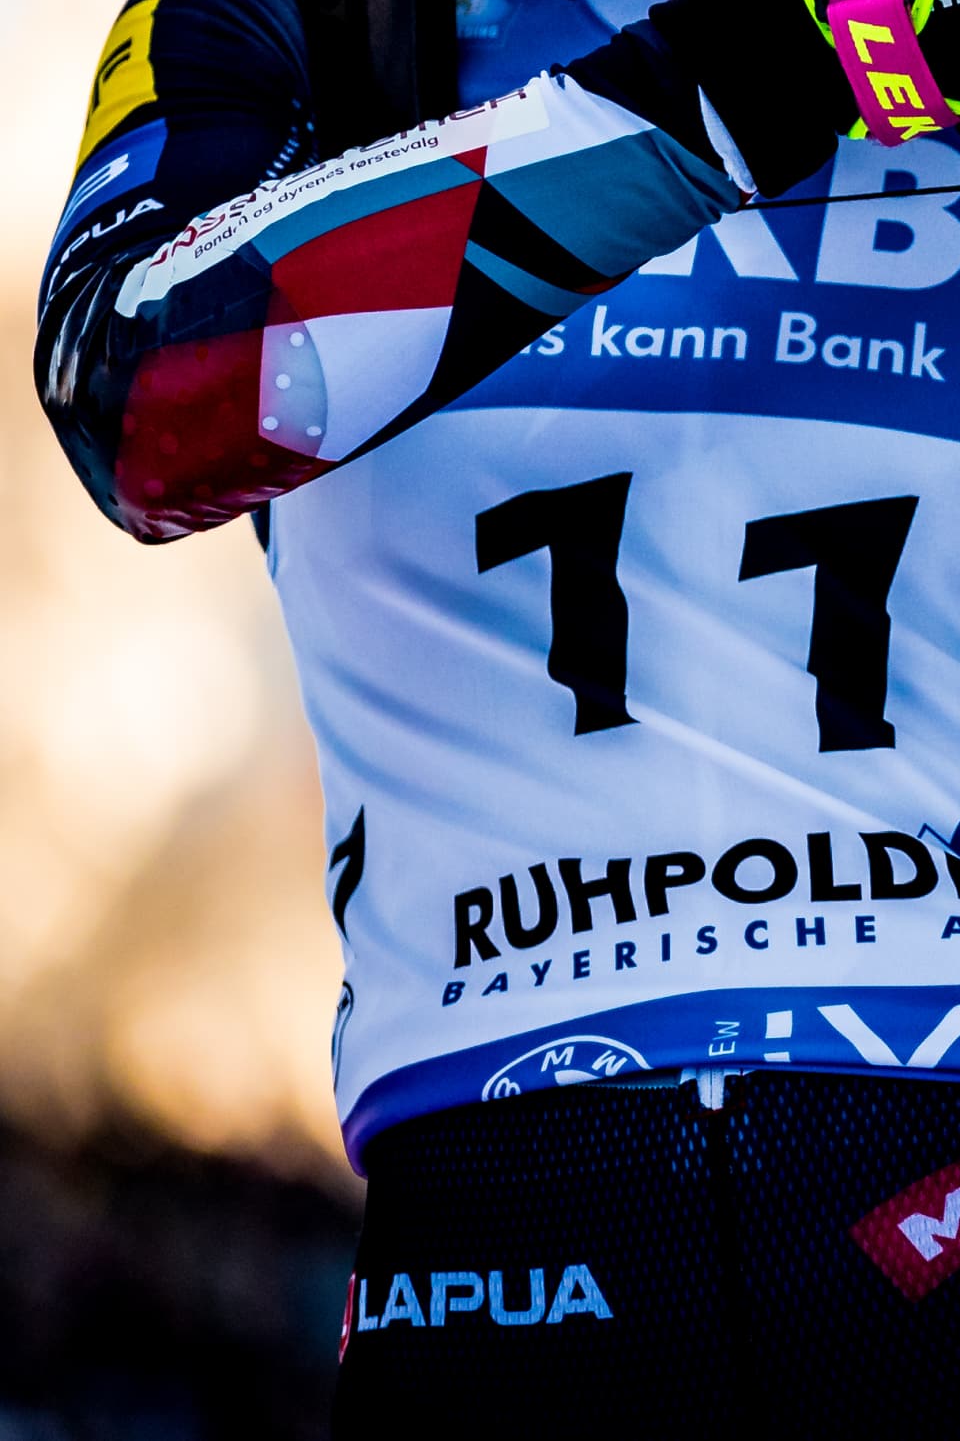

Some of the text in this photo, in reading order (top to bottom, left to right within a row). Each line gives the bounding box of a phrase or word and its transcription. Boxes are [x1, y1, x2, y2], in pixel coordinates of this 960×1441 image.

[193, 215, 249, 259] Bondn
[253, 201, 273, 219] og
[350, 134, 439, 171] førstevalg
[50, 198, 165, 286] PUA
[520, 305, 946, 382] s kann Bank
[475, 471, 919, 753] 11
[442, 915, 877, 1008] BAYERISCHE
[357, 1264, 614, 1333] LAPUA
